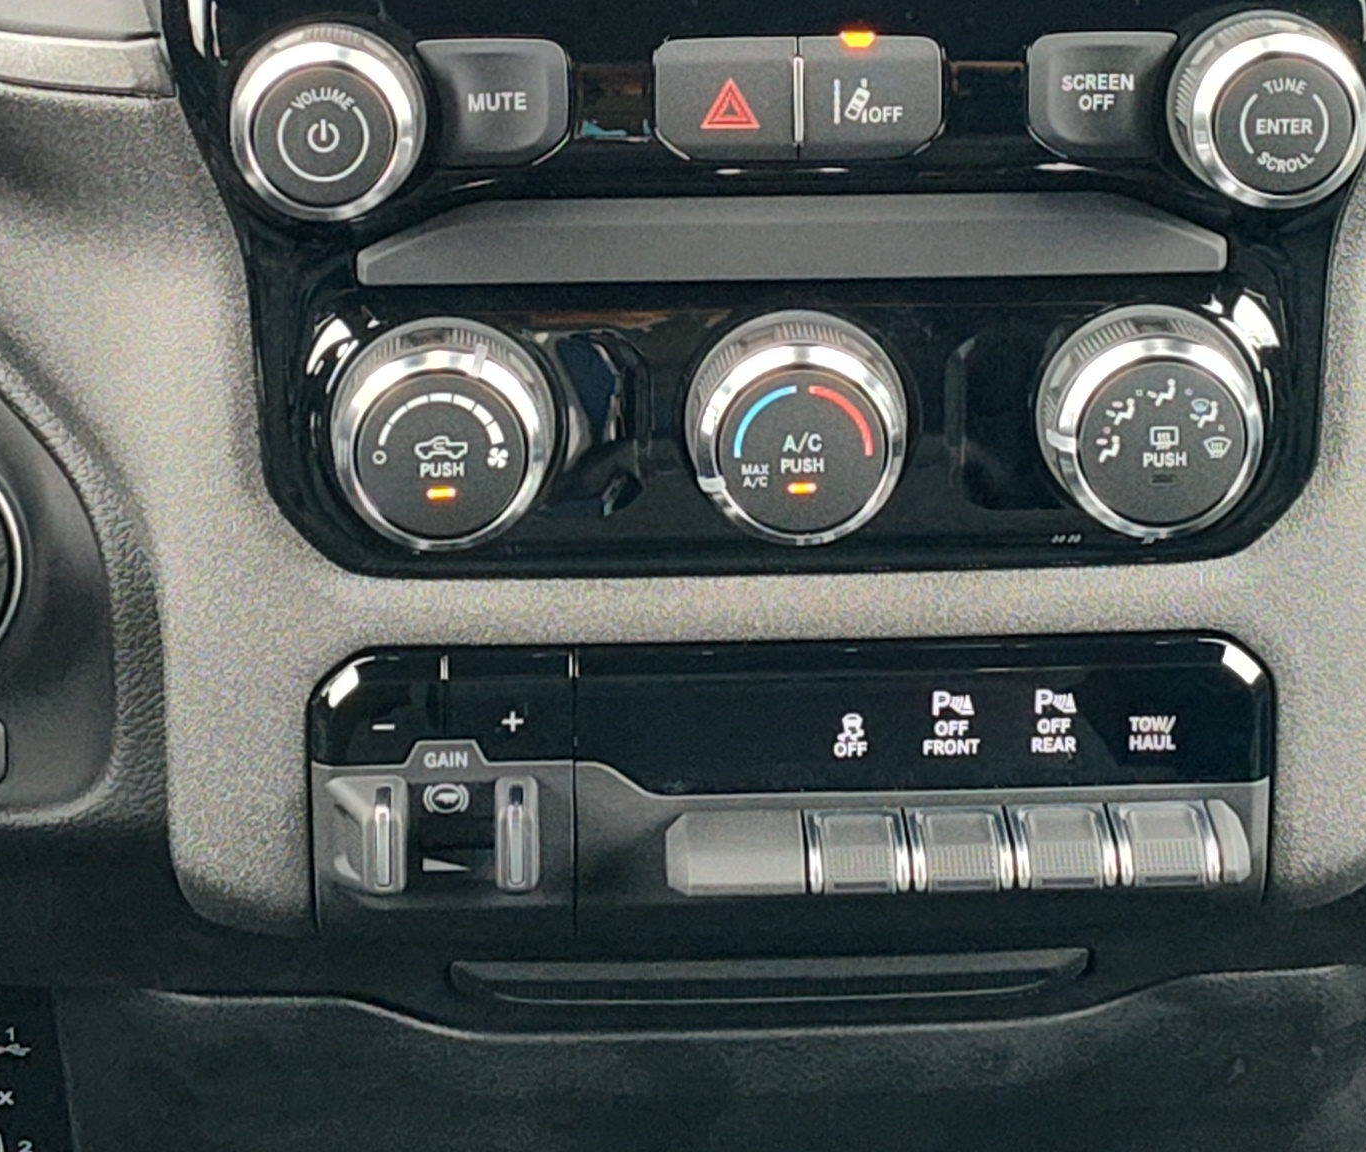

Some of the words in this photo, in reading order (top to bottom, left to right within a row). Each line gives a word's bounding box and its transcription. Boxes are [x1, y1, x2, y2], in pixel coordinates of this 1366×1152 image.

[1062, 73, 1134, 92] SCREEN
[1262, 77, 1308, 96] TUNE
[290, 86, 355, 112] VOLUME
[467, 92, 527, 112] MUTE
[1078, 93, 1115, 112] OFF
[868, 105, 903, 123] OFF
[1256, 118, 1313, 135] ENTER
[1256, 150, 1315, 174] SCROLL
[782, 431, 822, 453] A/C
[780, 458, 824, 474] PUSH
[1142, 452, 1187, 468] PUSH
[419, 462, 464, 478] PUSH
[741, 463, 769, 475] MAX
[743, 476, 769, 488] A/C
[934, 720, 969, 736] OFF
[1037, 718, 1071, 734] OFF
[1129, 715, 1176, 733] TOW/
[834, 741, 867, 757] OFF
[922, 738, 980, 755] FRONT
[1031, 736, 1076, 753] REAR
[1129, 735, 1176, 751] HAUL
[423, 751, 468, 768] GAIN
